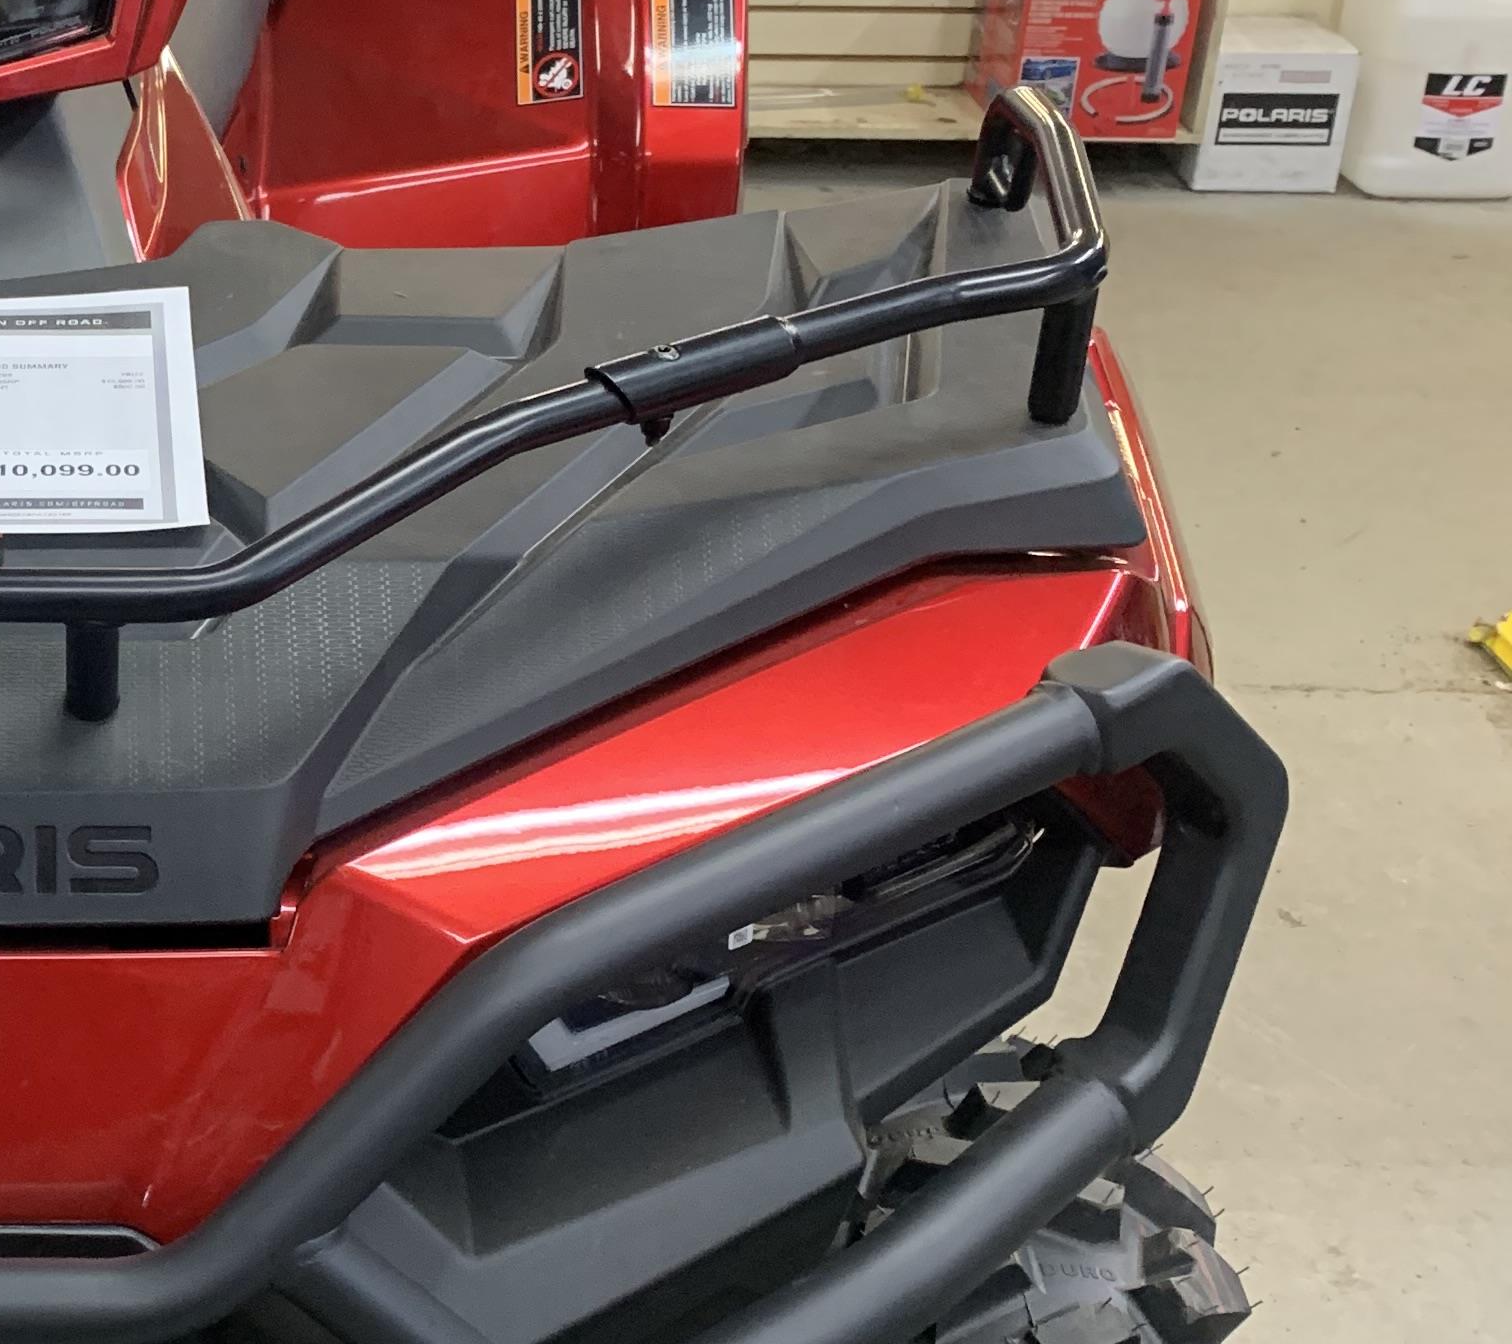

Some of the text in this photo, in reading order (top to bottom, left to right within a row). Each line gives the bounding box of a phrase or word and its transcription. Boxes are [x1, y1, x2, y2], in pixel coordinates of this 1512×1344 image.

[519, 10, 529, 66] WARNING
[1442, 75, 1492, 96] LC
[1221, 108, 1330, 123] POLARIS
